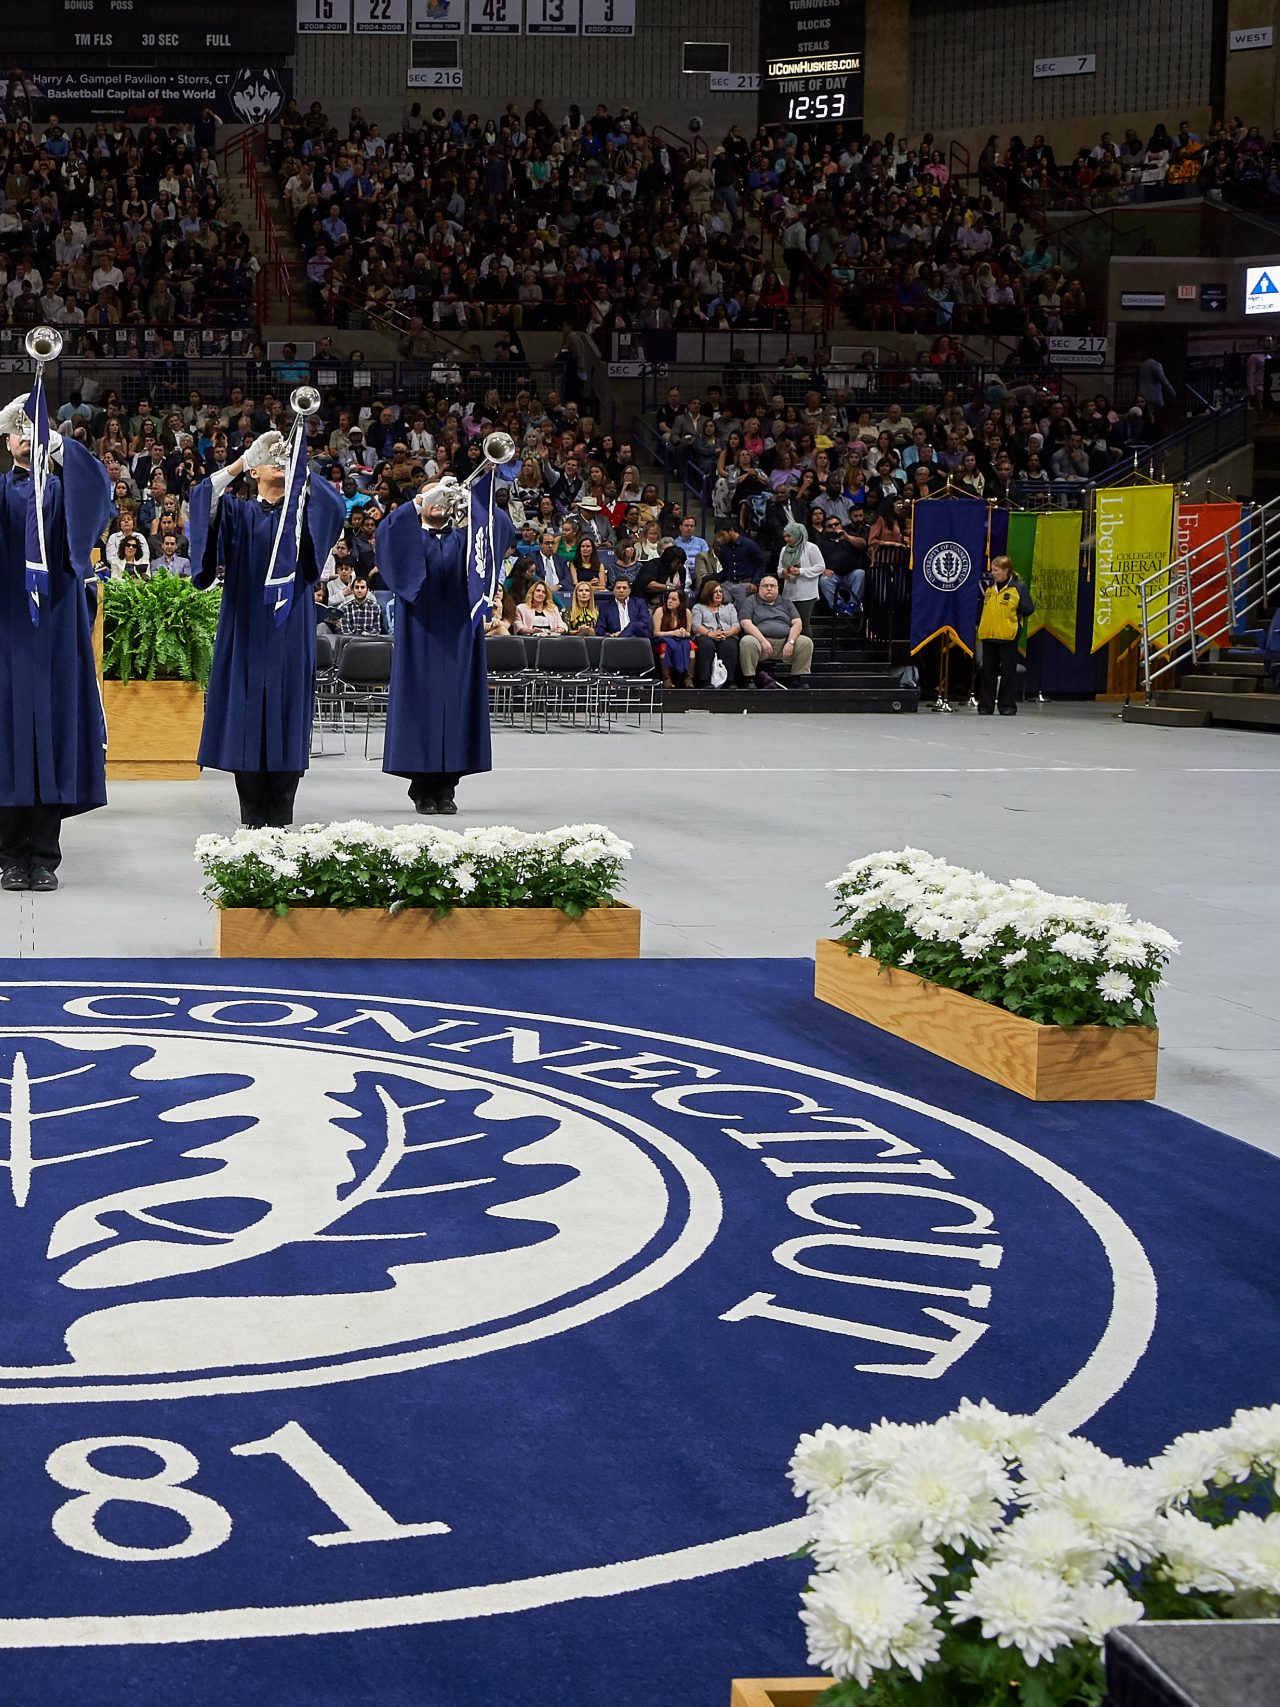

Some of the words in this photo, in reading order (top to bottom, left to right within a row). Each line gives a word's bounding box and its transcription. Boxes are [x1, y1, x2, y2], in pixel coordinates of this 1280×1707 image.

[64, 0, 94, 10] BONUS
[110, 0, 134, 10] POSS
[789, 0, 841, 11] TURNOVERS
[797, 18, 831, 31] BLOCKS
[74, 33, 91, 46] TM
[93, 33, 113, 46] FLS
[141, 34, 155, 46] 30
[157, 34, 180, 46] SEC
[205, 34, 231, 47] FULL
[1235, 32, 1268, 43] WEST
[797, 40, 830, 53] STEALS
[1035, 63, 1056, 73] SEC
[1078, 57, 1088, 71] 7
[32, 74, 62, 86] Harry
[65, 74, 77, 84] A.
[79, 74, 121, 86] Gampel
[124, 74, 167, 84] Pavilion
[177, 74, 213, 86] Storrs,
[215, 74, 231, 84] CT
[408, 74, 427, 83] SEC
[434, 72, 462, 84] 216
[711, 78, 730, 86] SEC
[737, 75, 763, 88] 217
[778, 80, 806, 94] TIME
[808, 78, 823, 91] OF
[825, 76, 848, 90] DAY
[47, 88, 105, 99] Basketball
[106, 88, 146, 101] Capital
[147, 88, 160, 99] of
[161, 88, 180, 99] the
[182, 88, 216, 99] World
[788, 93, 846, 120] 12:53
[1051, 340, 1070, 348] SEC
[1078, 338, 1105, 350] 217
[610, 366, 630, 375] SEC
[638, 363, 667, 377] 26
[1116, 551, 1154, 561] COLLEGE
[1154, 551, 1167, 560] OF
[62, 994, 1005, 1380] CONNECTICUT
